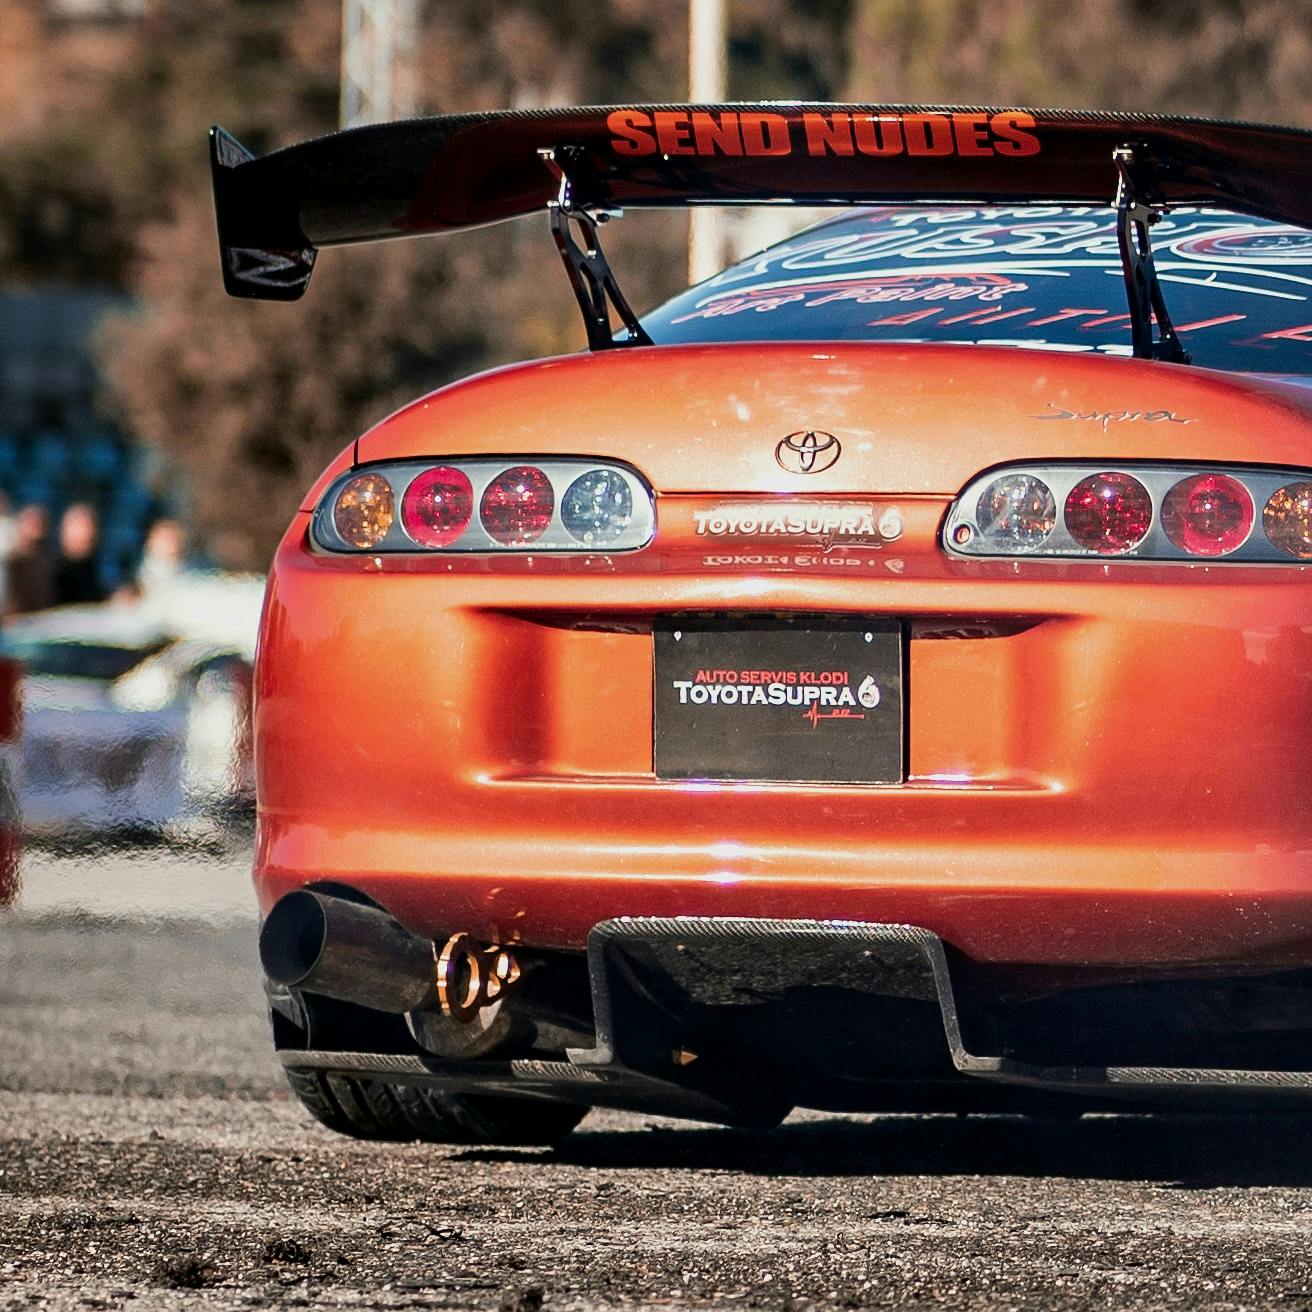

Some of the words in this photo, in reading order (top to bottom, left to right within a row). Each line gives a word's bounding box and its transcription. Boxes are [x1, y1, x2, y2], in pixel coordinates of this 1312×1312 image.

[606, 110, 791, 156] SEND
[802, 112, 1041, 157] NUDES
[805, 282, 1030, 307] Paint
[695, 670, 738, 684] AUTO
[740, 671, 796, 684] SERVIS
[800, 672, 848, 685] KLODI
